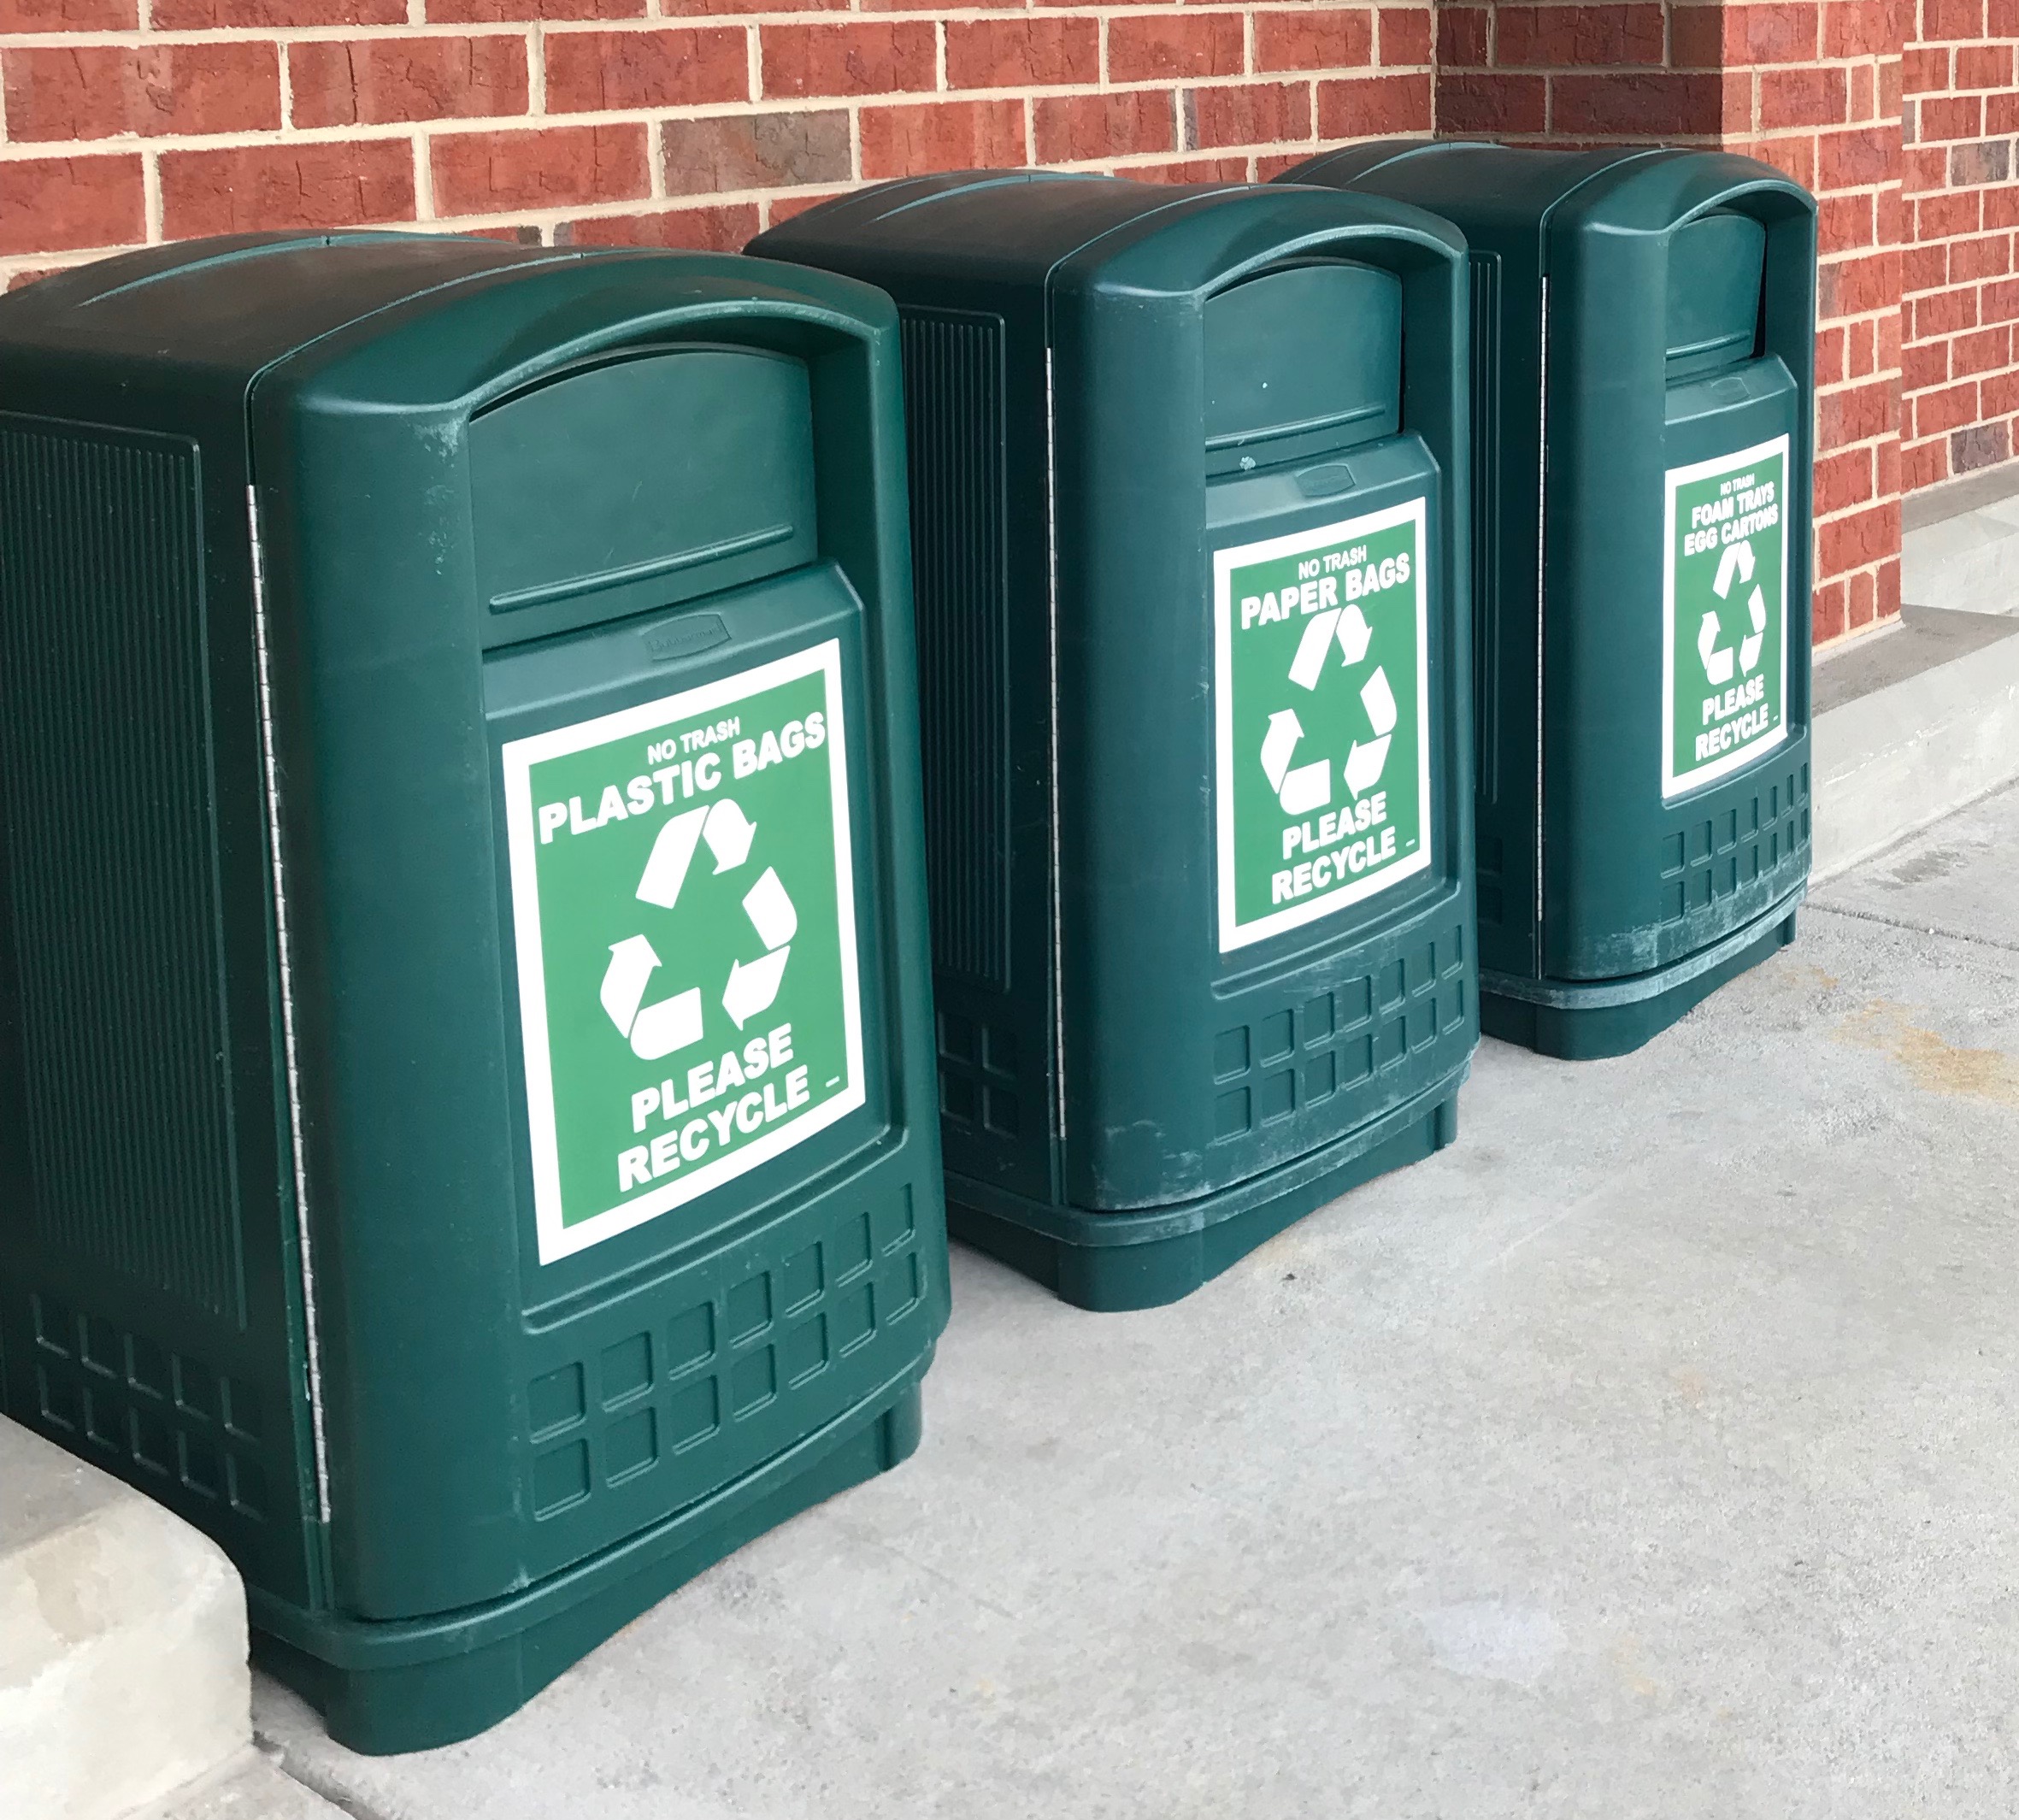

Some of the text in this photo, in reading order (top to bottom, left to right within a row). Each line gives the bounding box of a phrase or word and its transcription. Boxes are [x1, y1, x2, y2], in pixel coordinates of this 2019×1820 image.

[1692, 480, 1775, 529] FOAM TRAYS
[1720, 473, 1755, 496] NO TRASH
[1684, 503, 1778, 557] EGG CARTONS
[1241, 552, 1410, 630] PAPER BAGS
[1298, 545, 1367, 580] NO TRASH
[1702, 673, 1764, 726] PLEASE
[648, 716, 739, 764] NO TRASH
[1695, 703, 1769, 762] RECYCLE
[539, 711, 825, 844] PLASTIC BAGS
[1282, 791, 1386, 860] PLEASE
[1272, 826, 1396, 904] RECYCLE
[632, 1022, 793, 1133] PLEASE
[618, 1064, 809, 1193] RECYCLE
